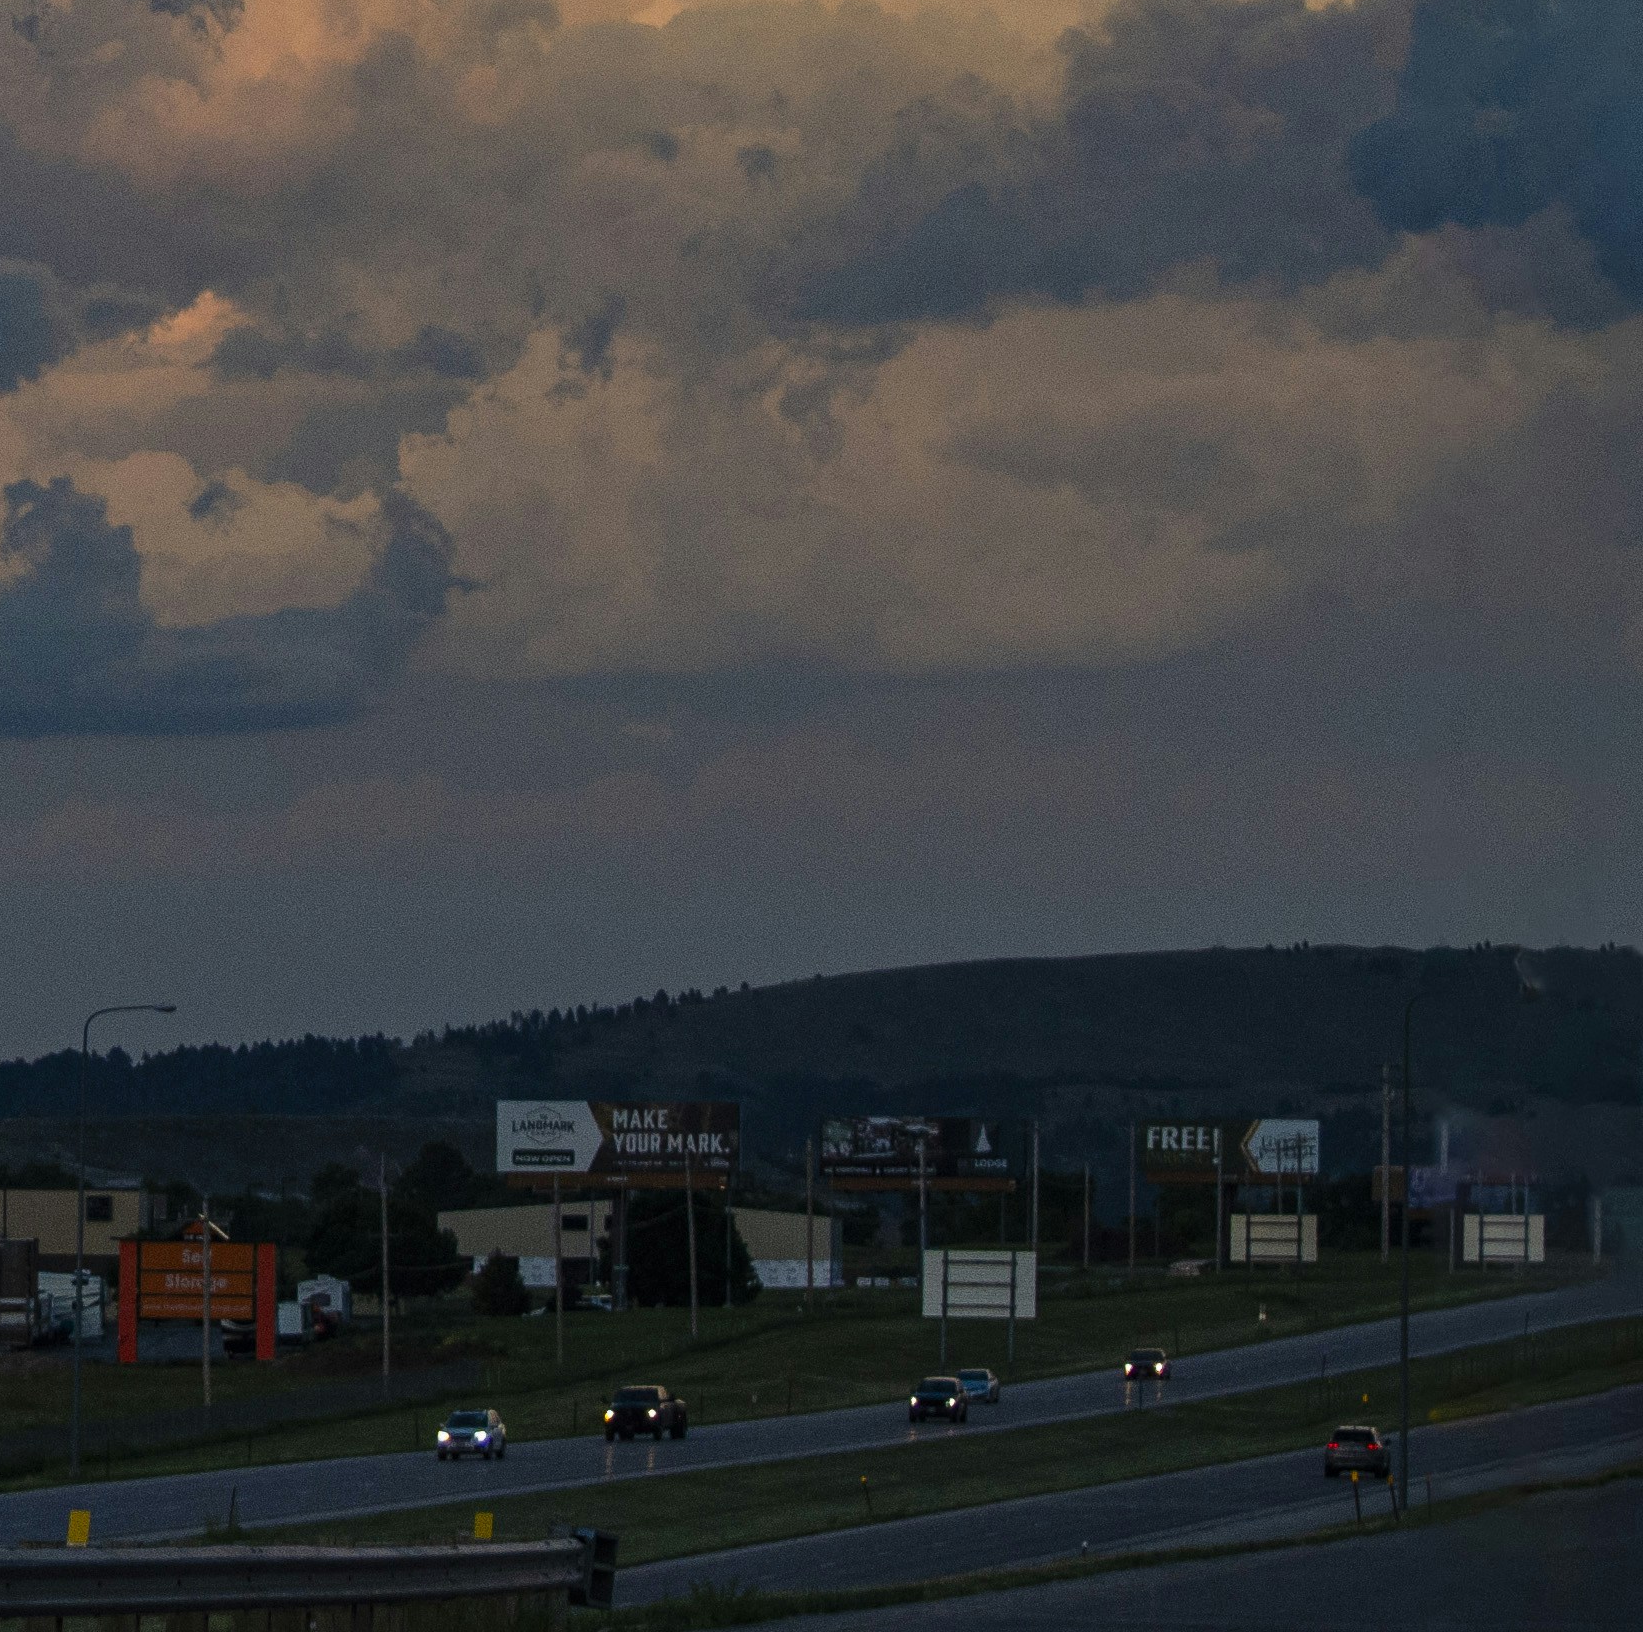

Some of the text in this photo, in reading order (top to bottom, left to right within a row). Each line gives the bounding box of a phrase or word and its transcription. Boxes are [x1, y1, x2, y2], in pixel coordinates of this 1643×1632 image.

[512, 1120, 575, 1133] LANDMARK
[612, 1109, 669, 1130] MAKE
[612, 1133, 731, 1154] YOUR MARK.
[1146, 1125, 1221, 1165] FREE!
[515, 1154, 571, 1163] NOW OPEN
[974, 1158, 1008, 1168] LODGE
[181, 1248, 213, 1264] Se
